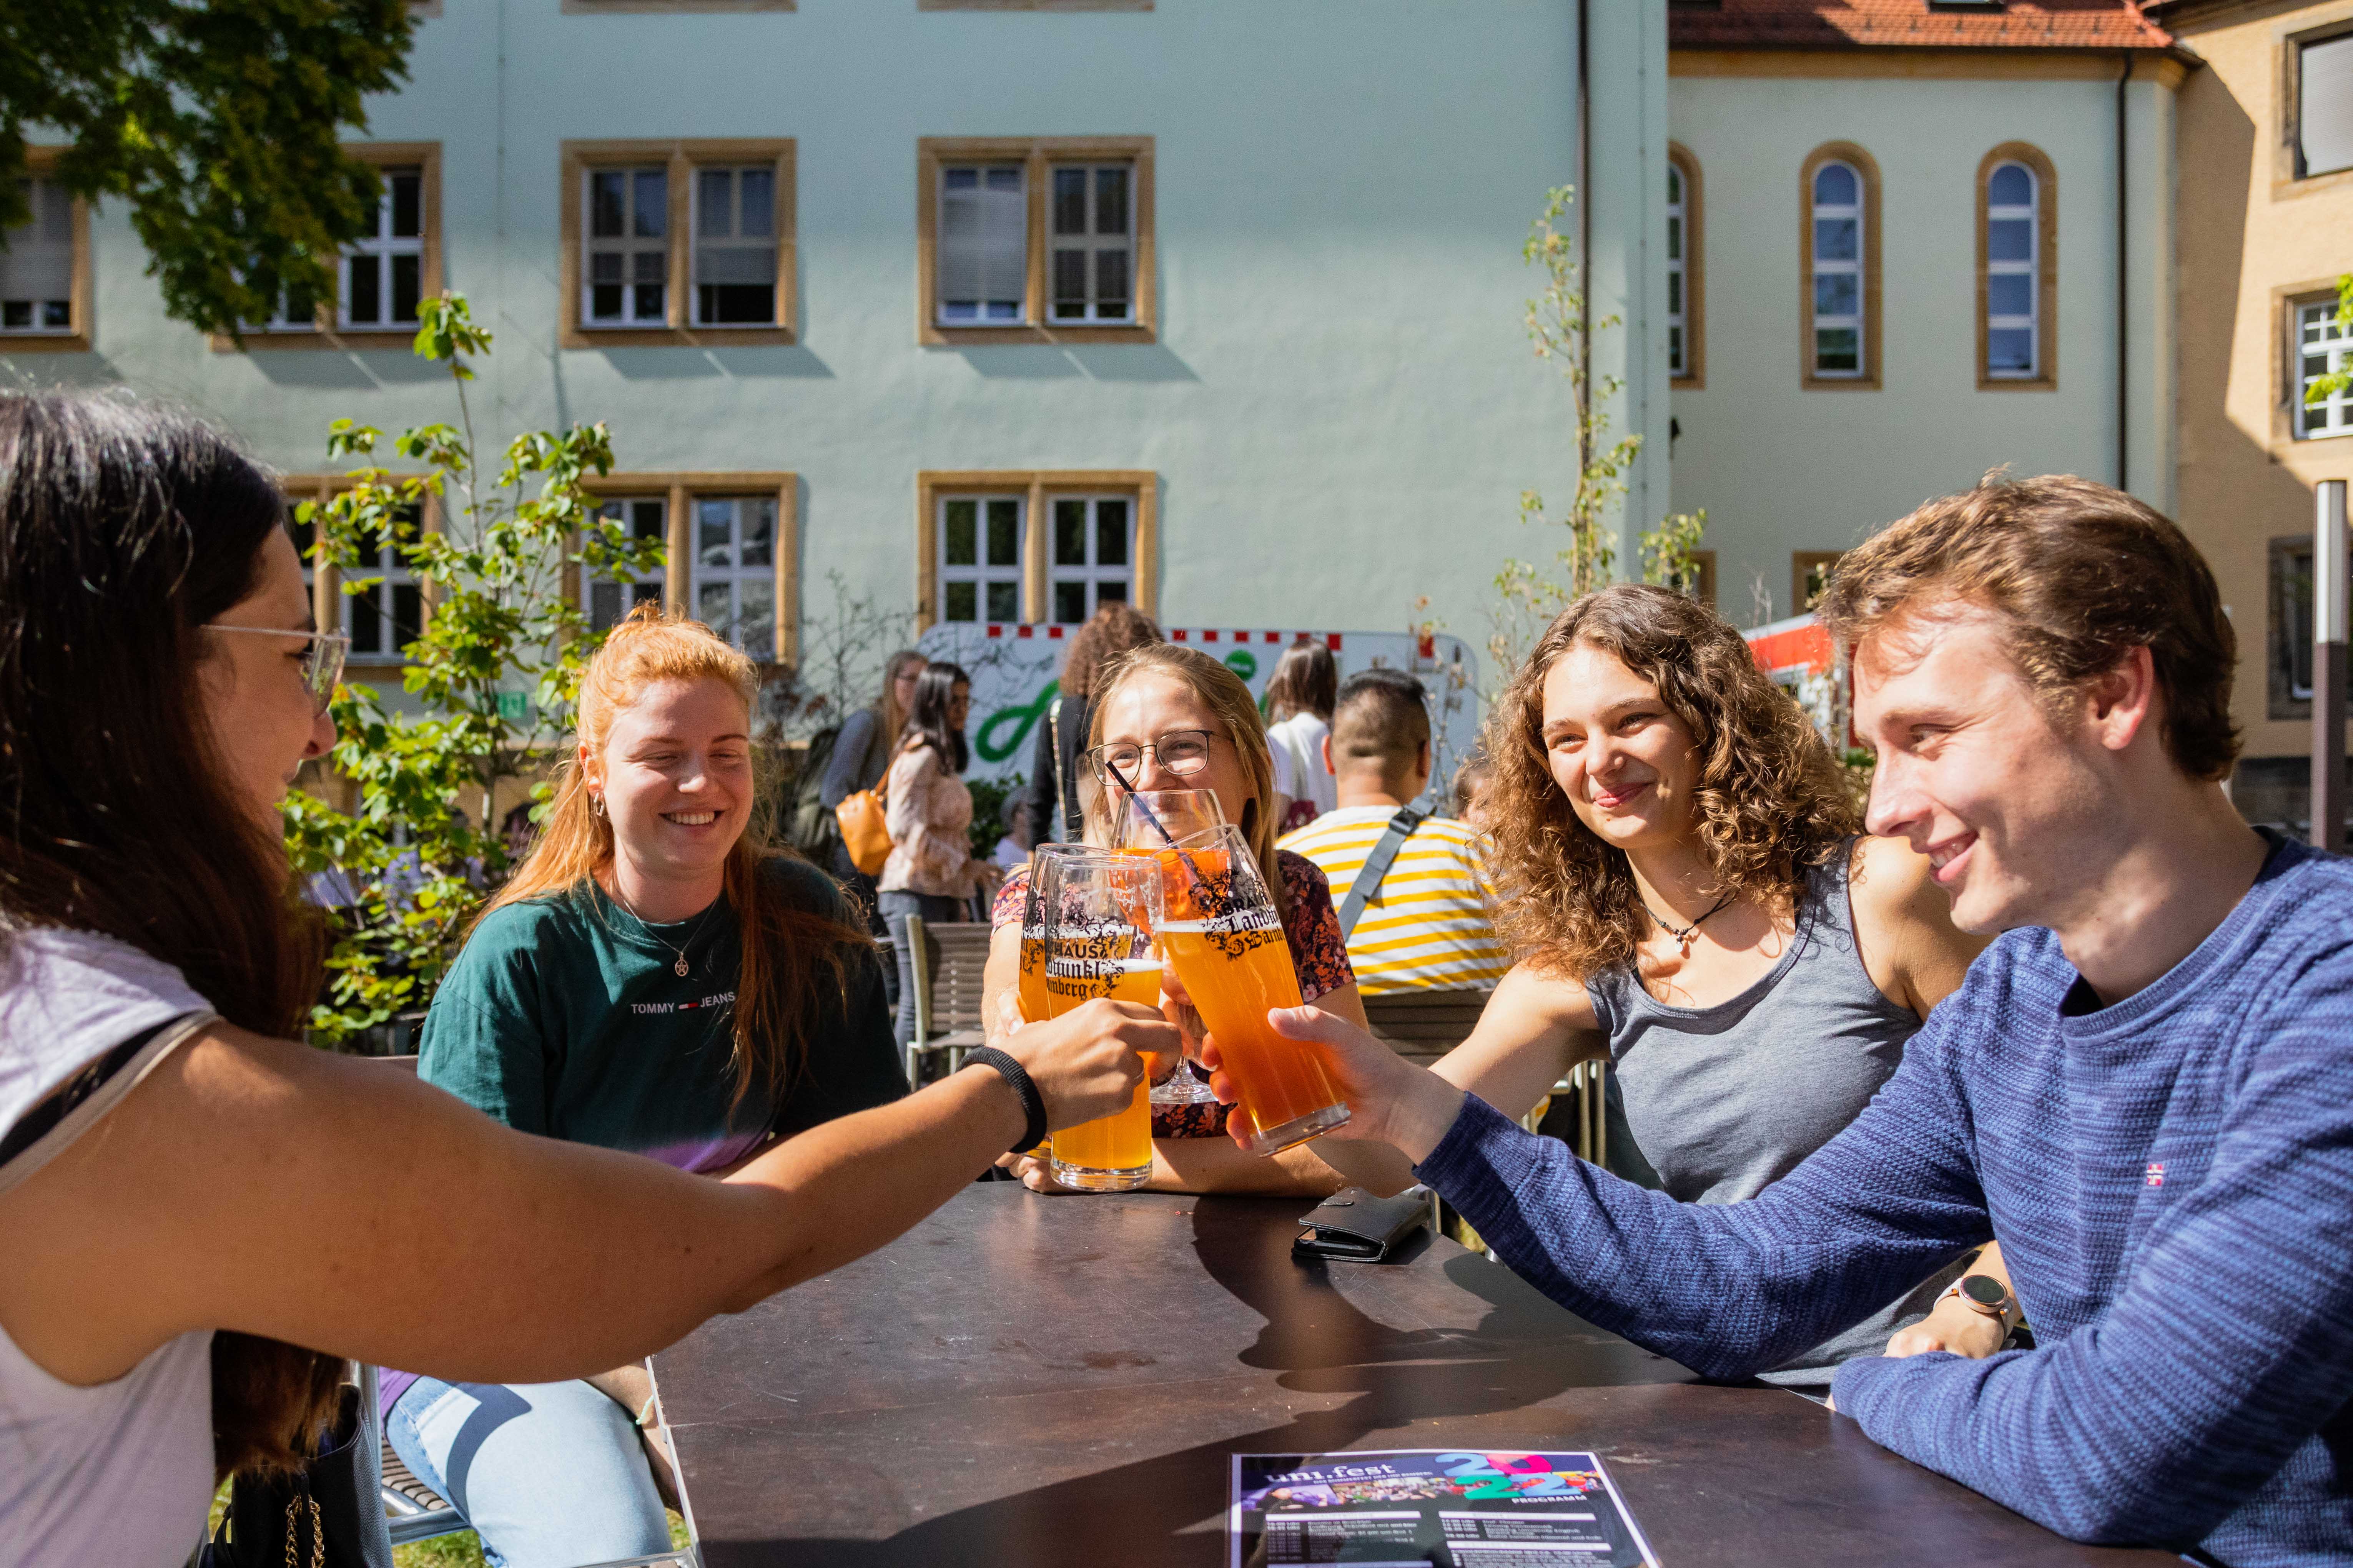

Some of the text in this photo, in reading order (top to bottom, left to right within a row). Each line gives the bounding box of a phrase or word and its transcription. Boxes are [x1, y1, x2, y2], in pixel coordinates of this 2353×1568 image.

[1054, 941, 1099, 959] HAUS
[630, 991, 736, 1014] TOMMY JEANS
[1265, 1463, 1397, 1483] uni.fest
[1511, 1495, 1587, 1504] PROGRAMM
